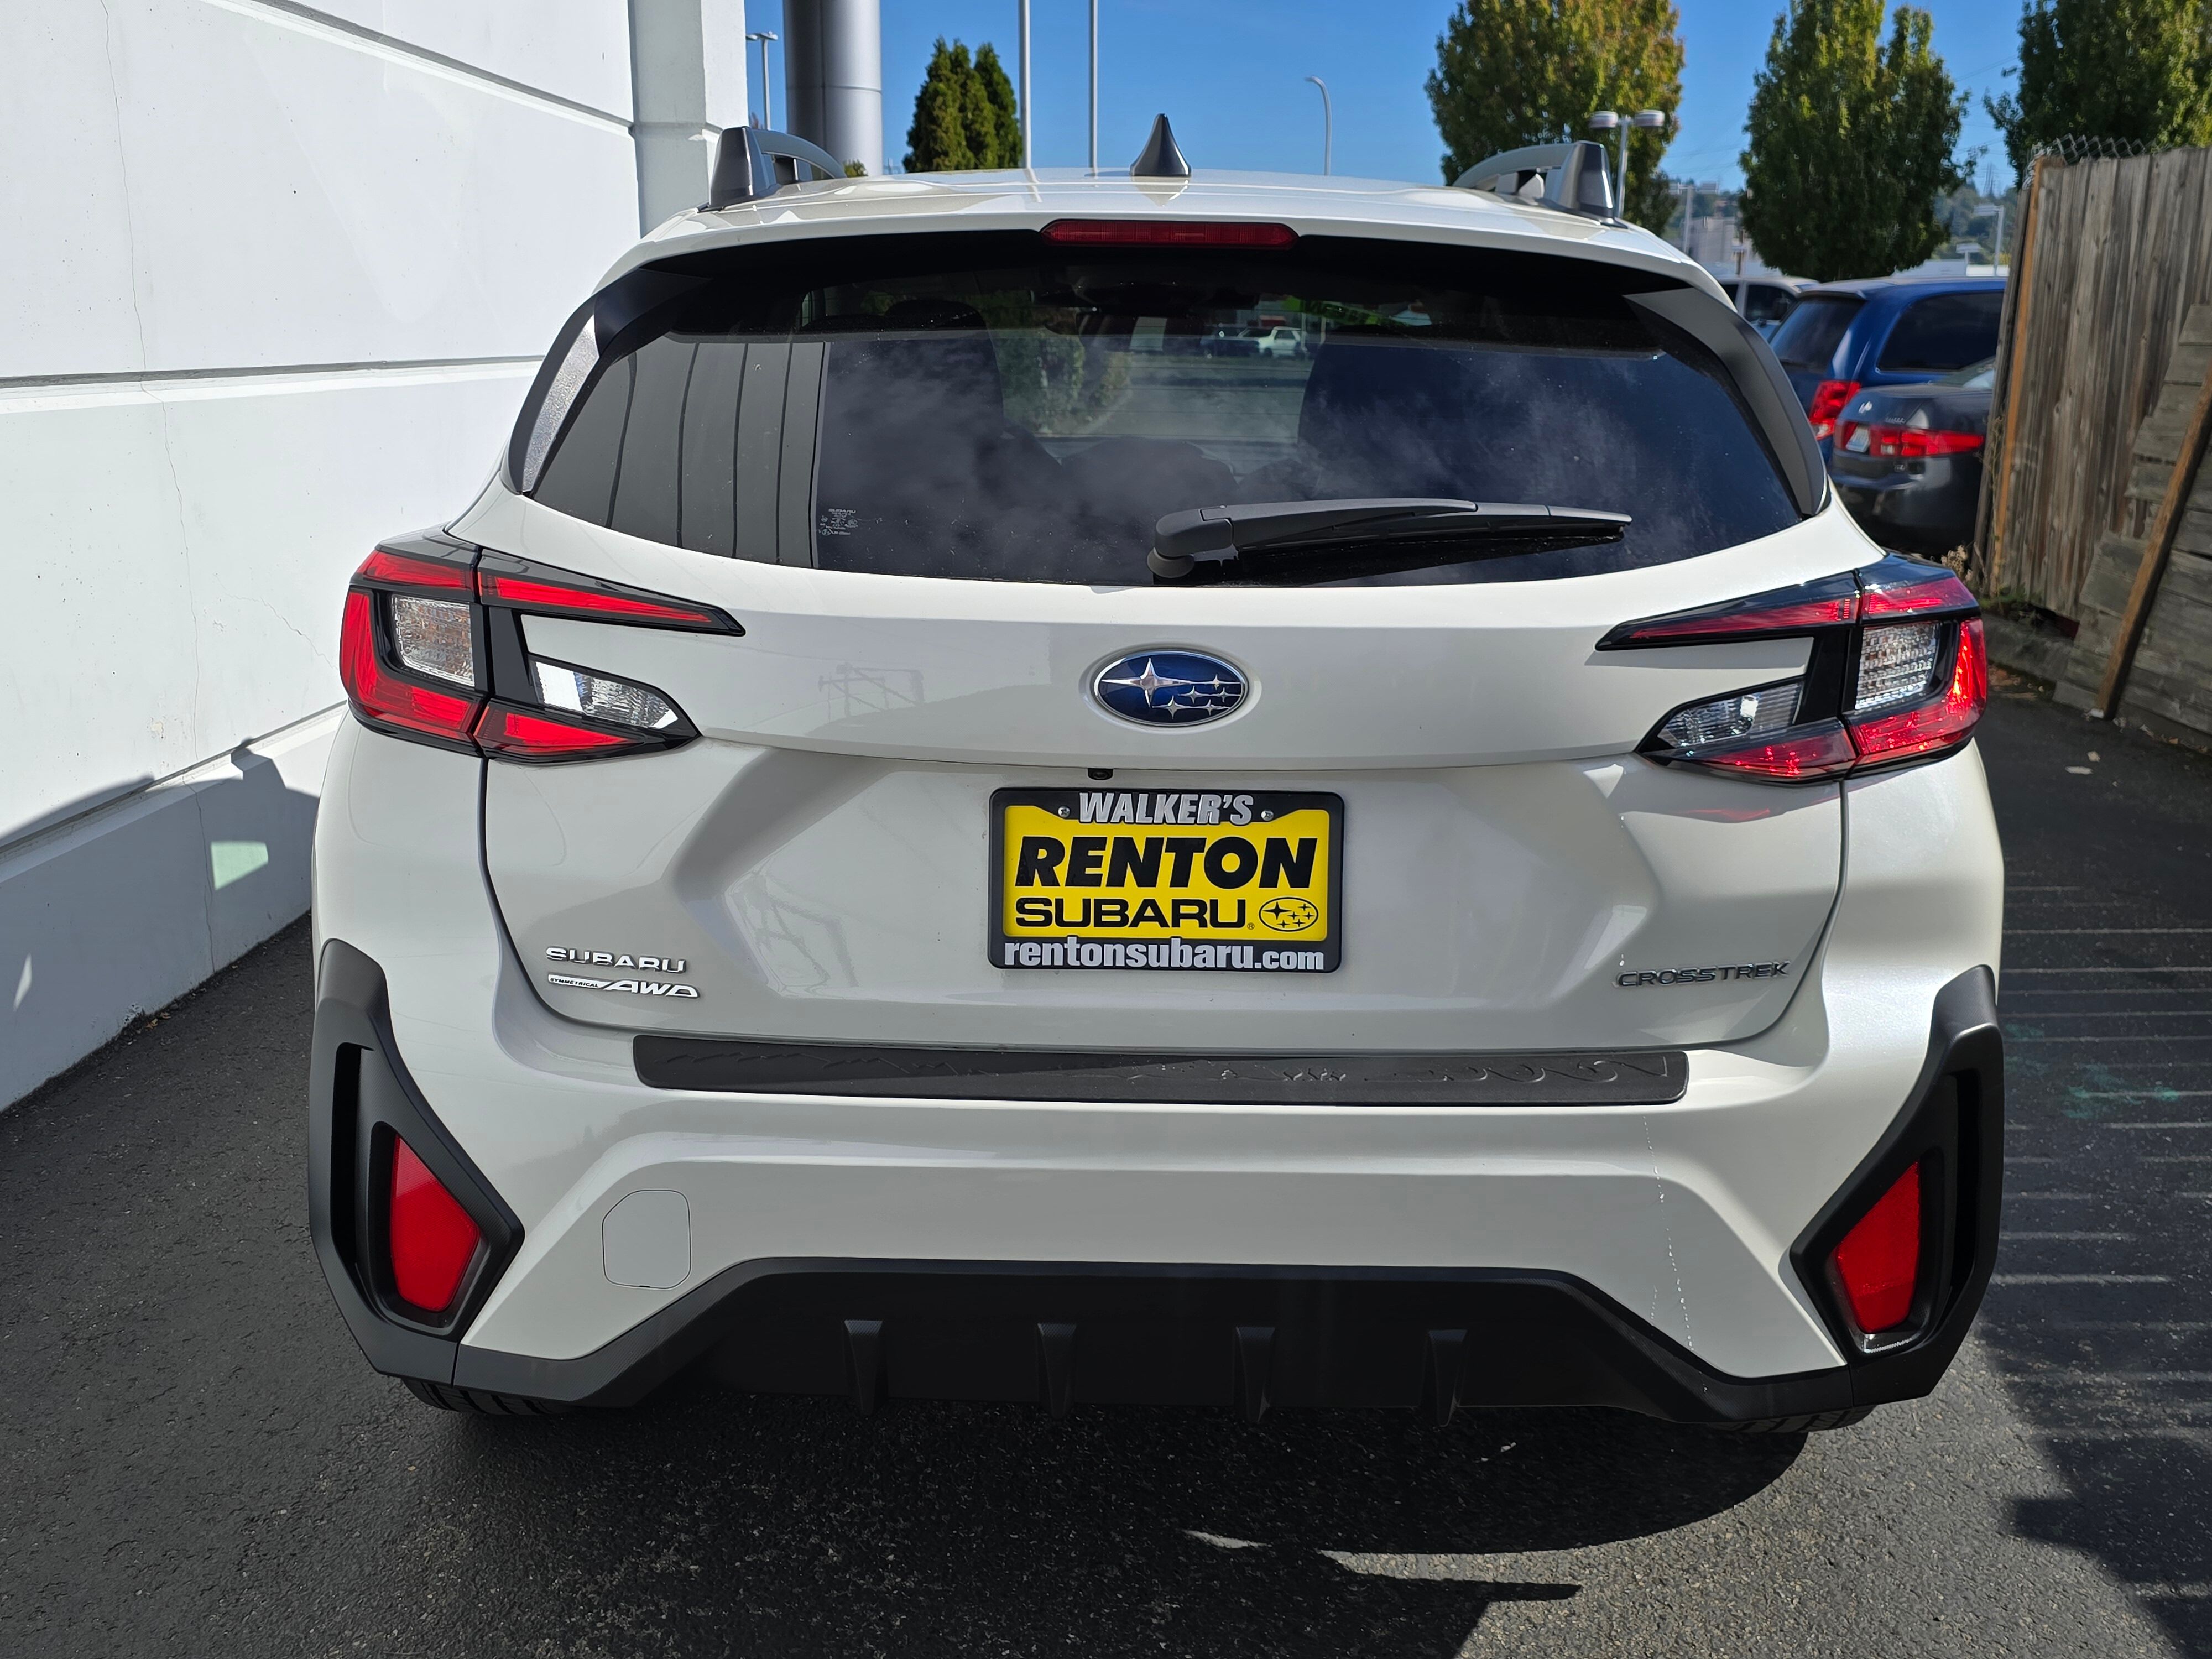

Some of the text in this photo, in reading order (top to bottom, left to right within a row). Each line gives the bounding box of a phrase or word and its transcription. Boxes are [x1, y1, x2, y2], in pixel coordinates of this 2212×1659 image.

[1079, 792, 1254, 825] WALKER'S
[1015, 836, 1318, 889] RENTON
[1015, 897, 1246, 928] SUBARU
[546, 946, 686, 973] SUBARU
[1004, 936, 1324, 971] rentonsubaru.com
[550, 978, 700, 998] SYMMETRICAL AWD
[1616, 960, 1791, 988] CROSSTREK
